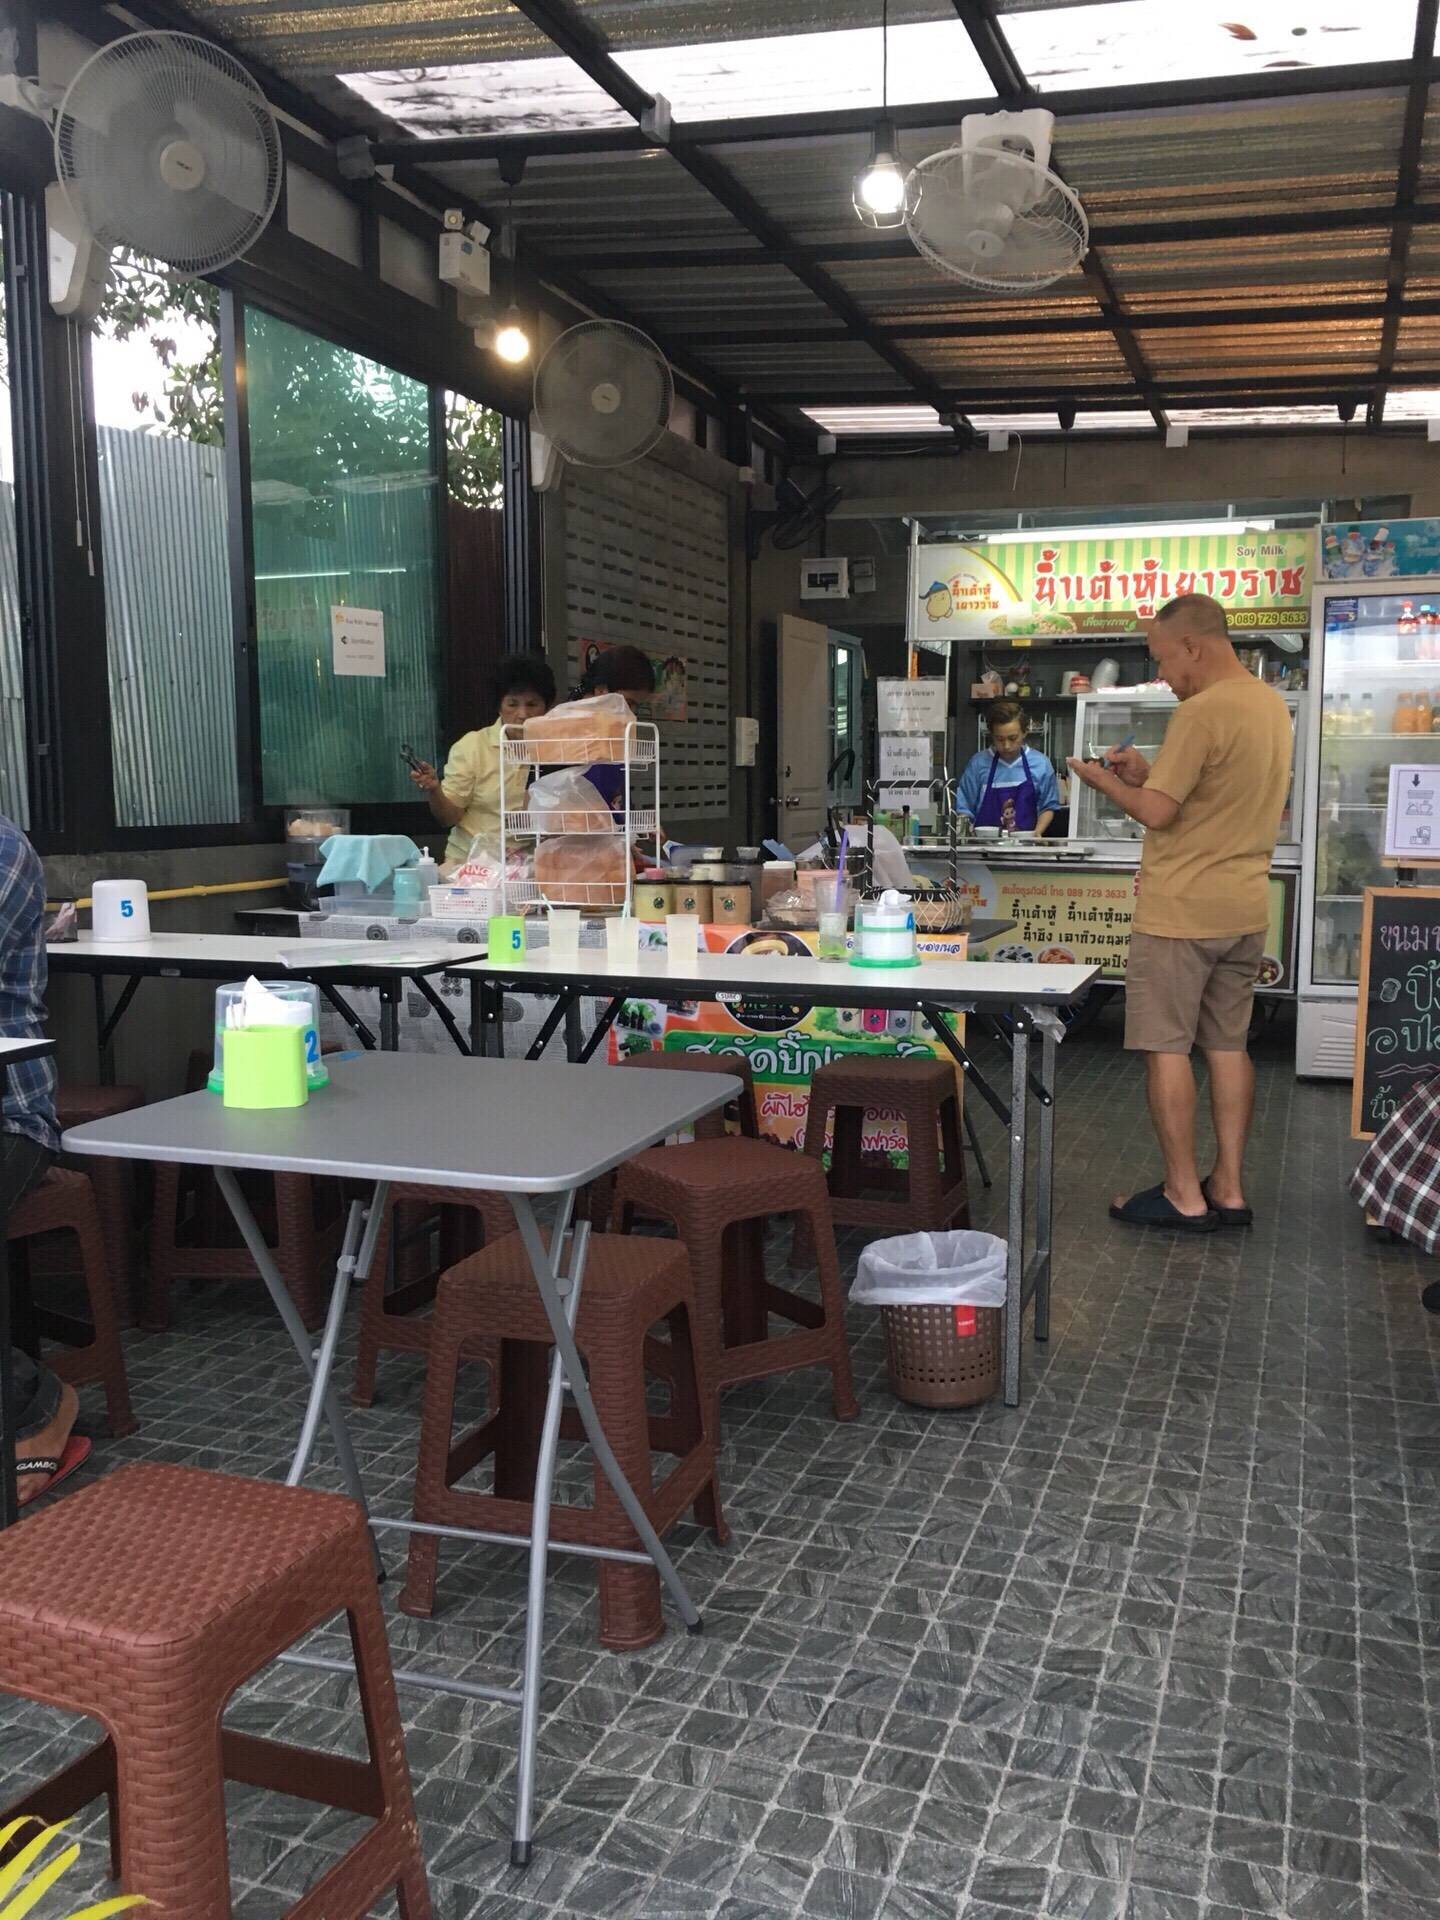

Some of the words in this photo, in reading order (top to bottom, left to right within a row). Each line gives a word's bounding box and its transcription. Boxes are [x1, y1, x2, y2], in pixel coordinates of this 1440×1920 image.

[1236, 546, 1256, 558] Soy
[1260, 545, 1284, 556] Milk
[1034, 549, 1305, 618] น้ำเต้าหู้เยาวราช
[1236, 612, 1257, 625] 089
[1258, 611, 1279, 625] 729
[1280, 611, 1307, 625] 3633
[1067, 887, 1083, 897] 089
[1087, 888, 1103, 898] 729
[1105, 888, 1128, 899] 3633
[120, 899, 134, 918] 5
[1011, 898, 1057, 926] น้ำเต้าหู้
[1067, 901, 1132, 929] น้ำเต้าหู้นม
[511, 929, 522, 950] 5
[1023, 921, 1053, 942] น้ำขิง
[303, 1030, 320, 1064] 2
